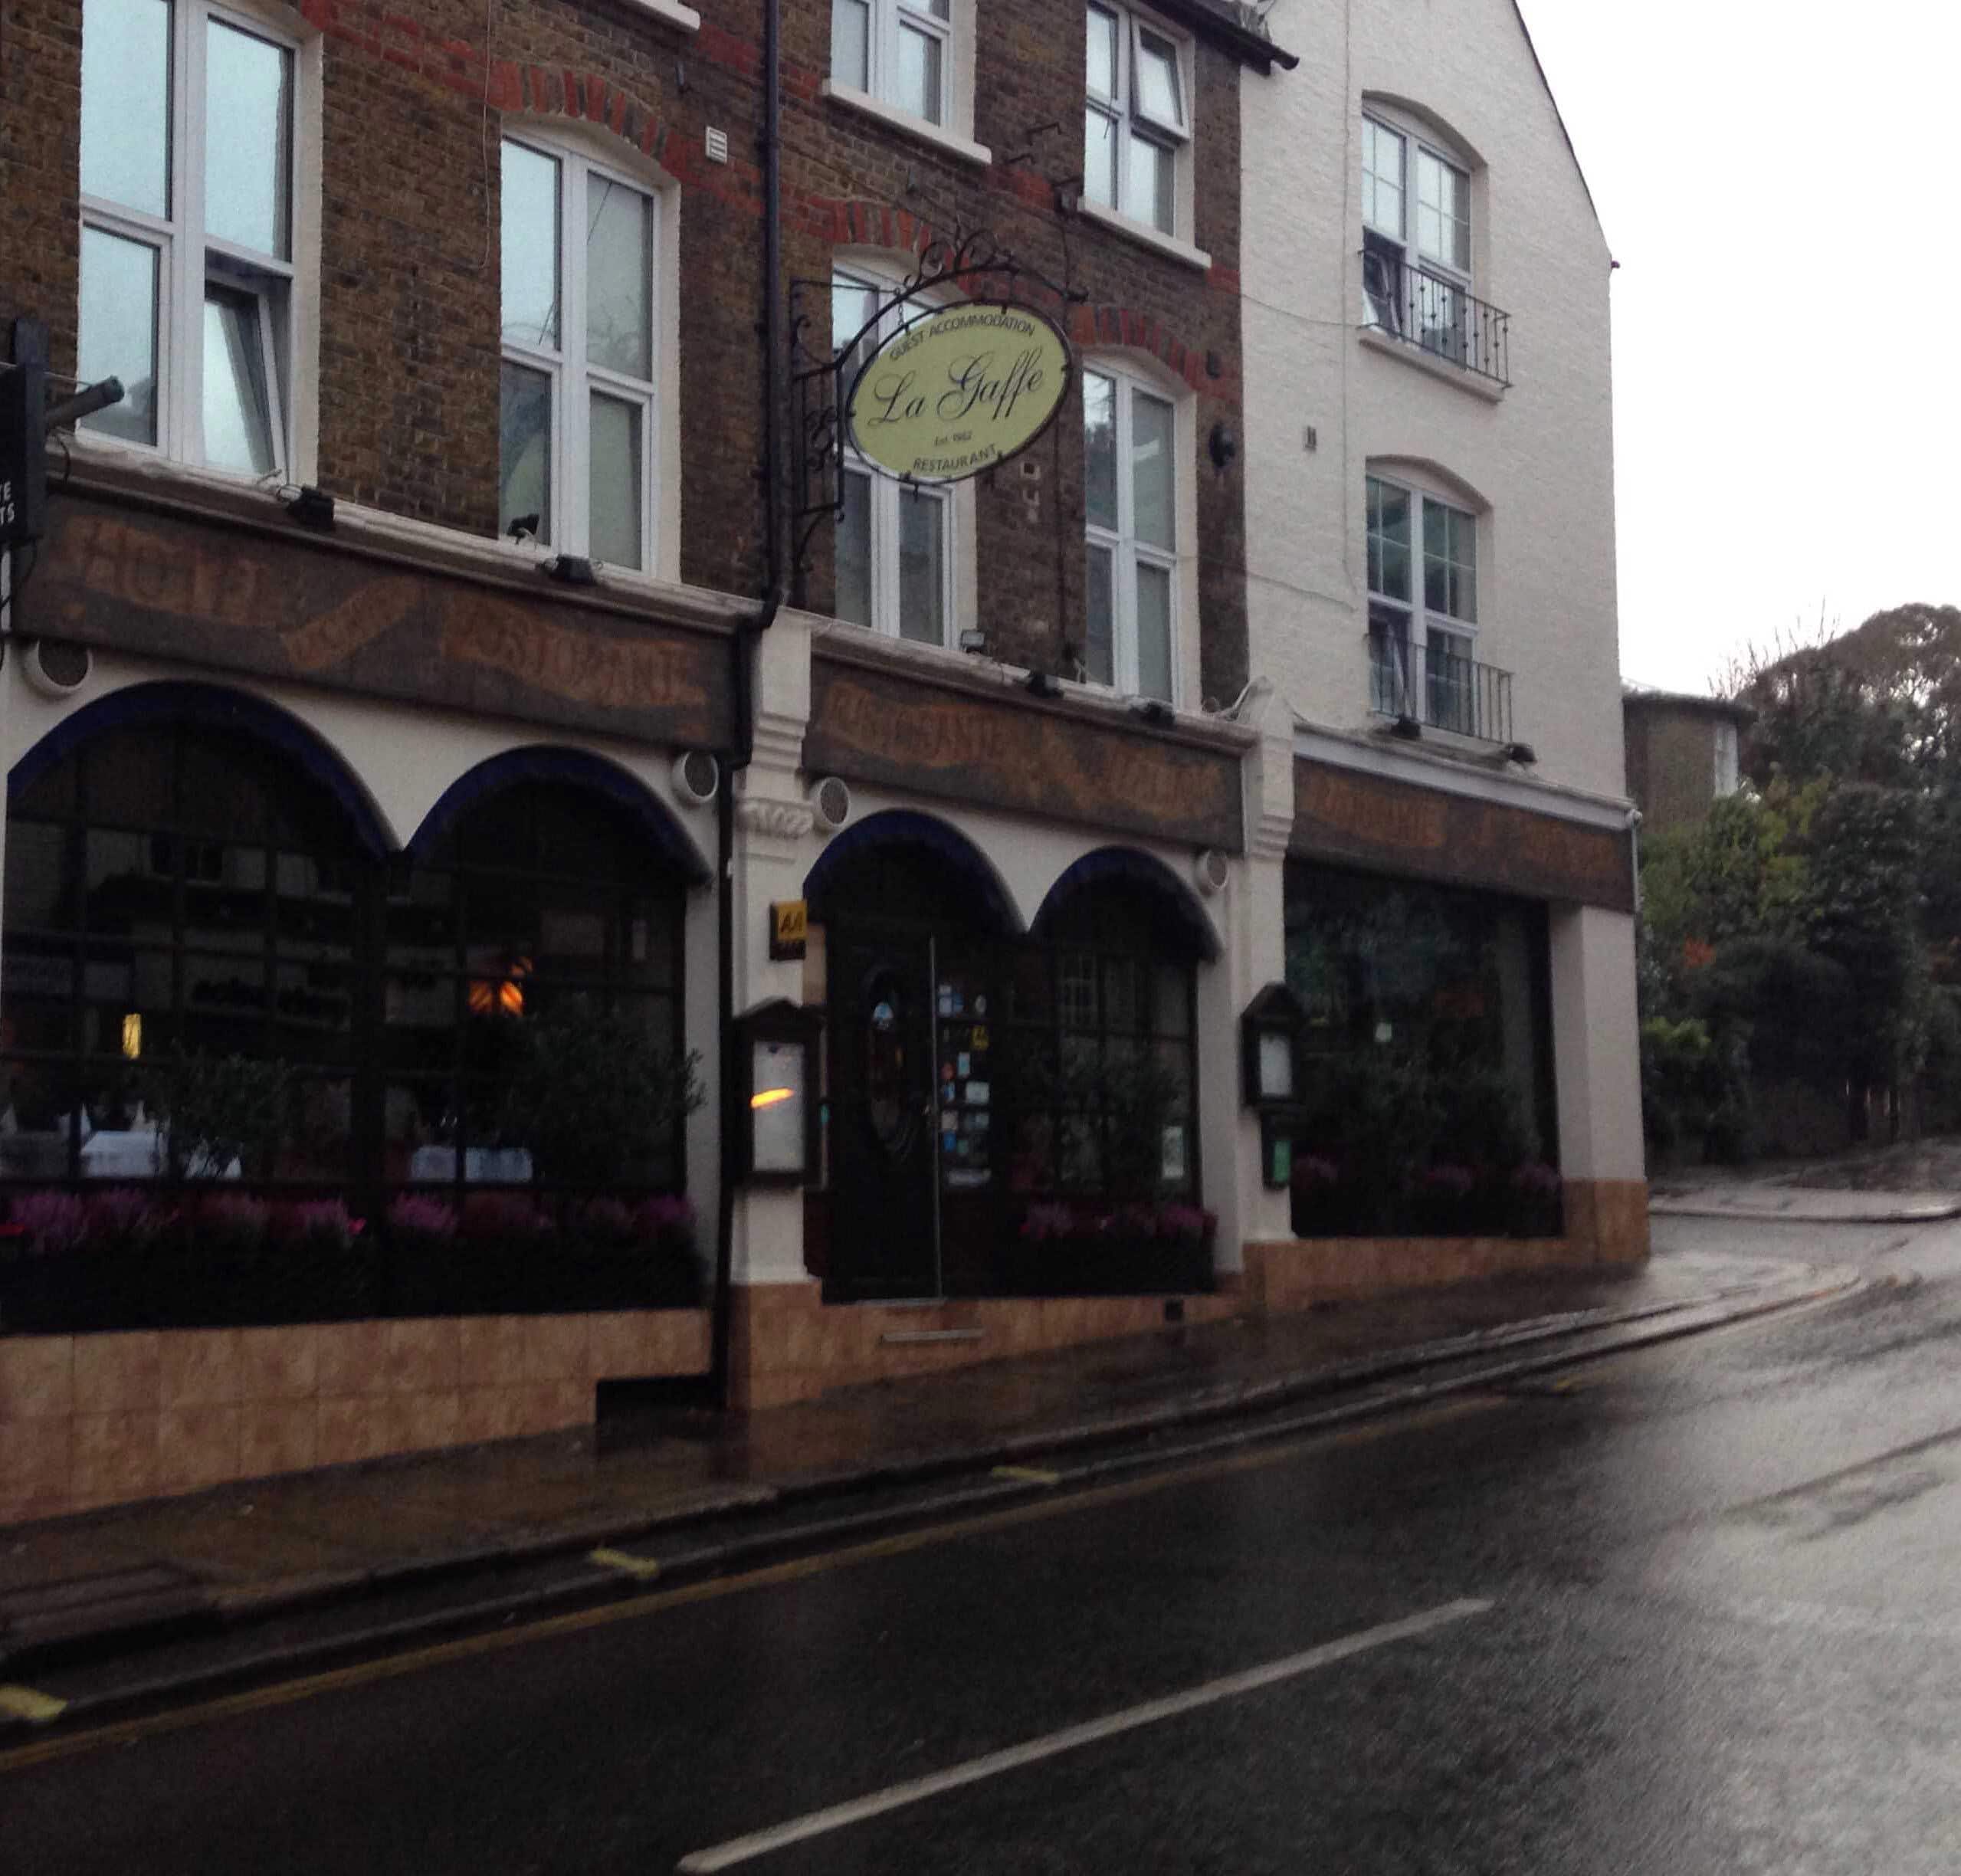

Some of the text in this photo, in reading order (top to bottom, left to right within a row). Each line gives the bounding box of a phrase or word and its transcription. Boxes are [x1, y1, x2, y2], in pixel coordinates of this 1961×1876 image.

[890, 314, 1035, 361] GUEST ACCOMMODATION
[868, 348, 1044, 425] La Gaffe
[913, 444, 996, 471] RESTAURANT
